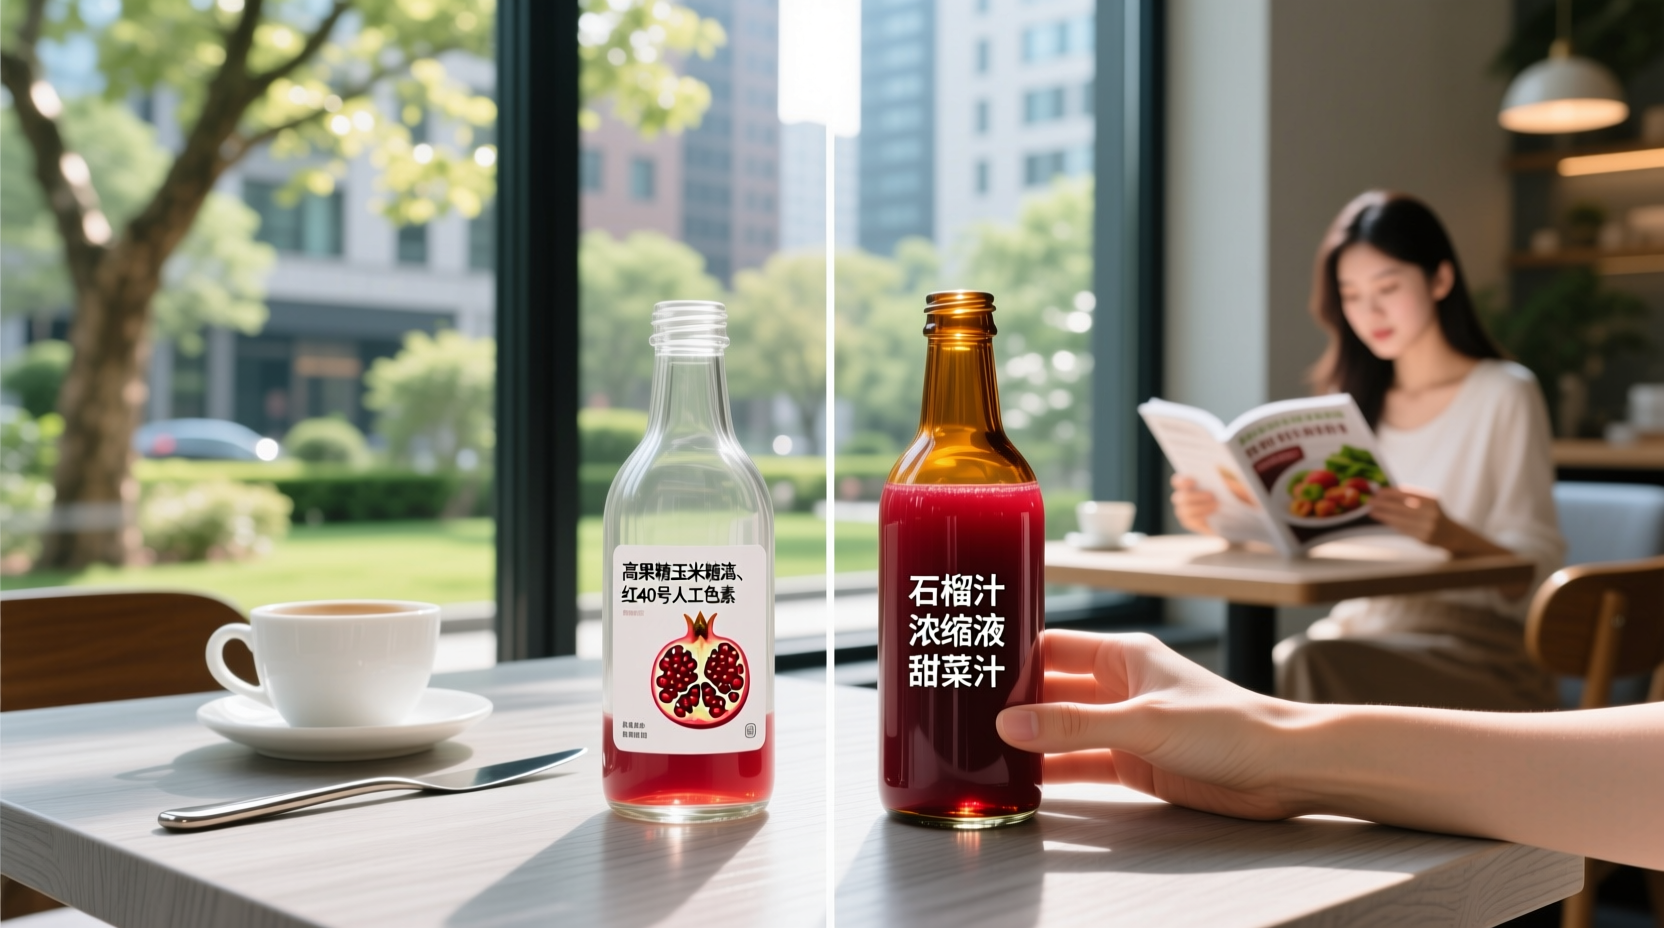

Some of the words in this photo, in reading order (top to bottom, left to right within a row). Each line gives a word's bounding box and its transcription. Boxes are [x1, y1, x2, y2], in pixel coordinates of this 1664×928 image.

[621, 585, 736, 605] 红40号人工色素
[908, 573, 1006, 607] 石榴汁
[908, 612, 1006, 648] 浓缩液
[908, 653, 1006, 689] 甜菜汁
